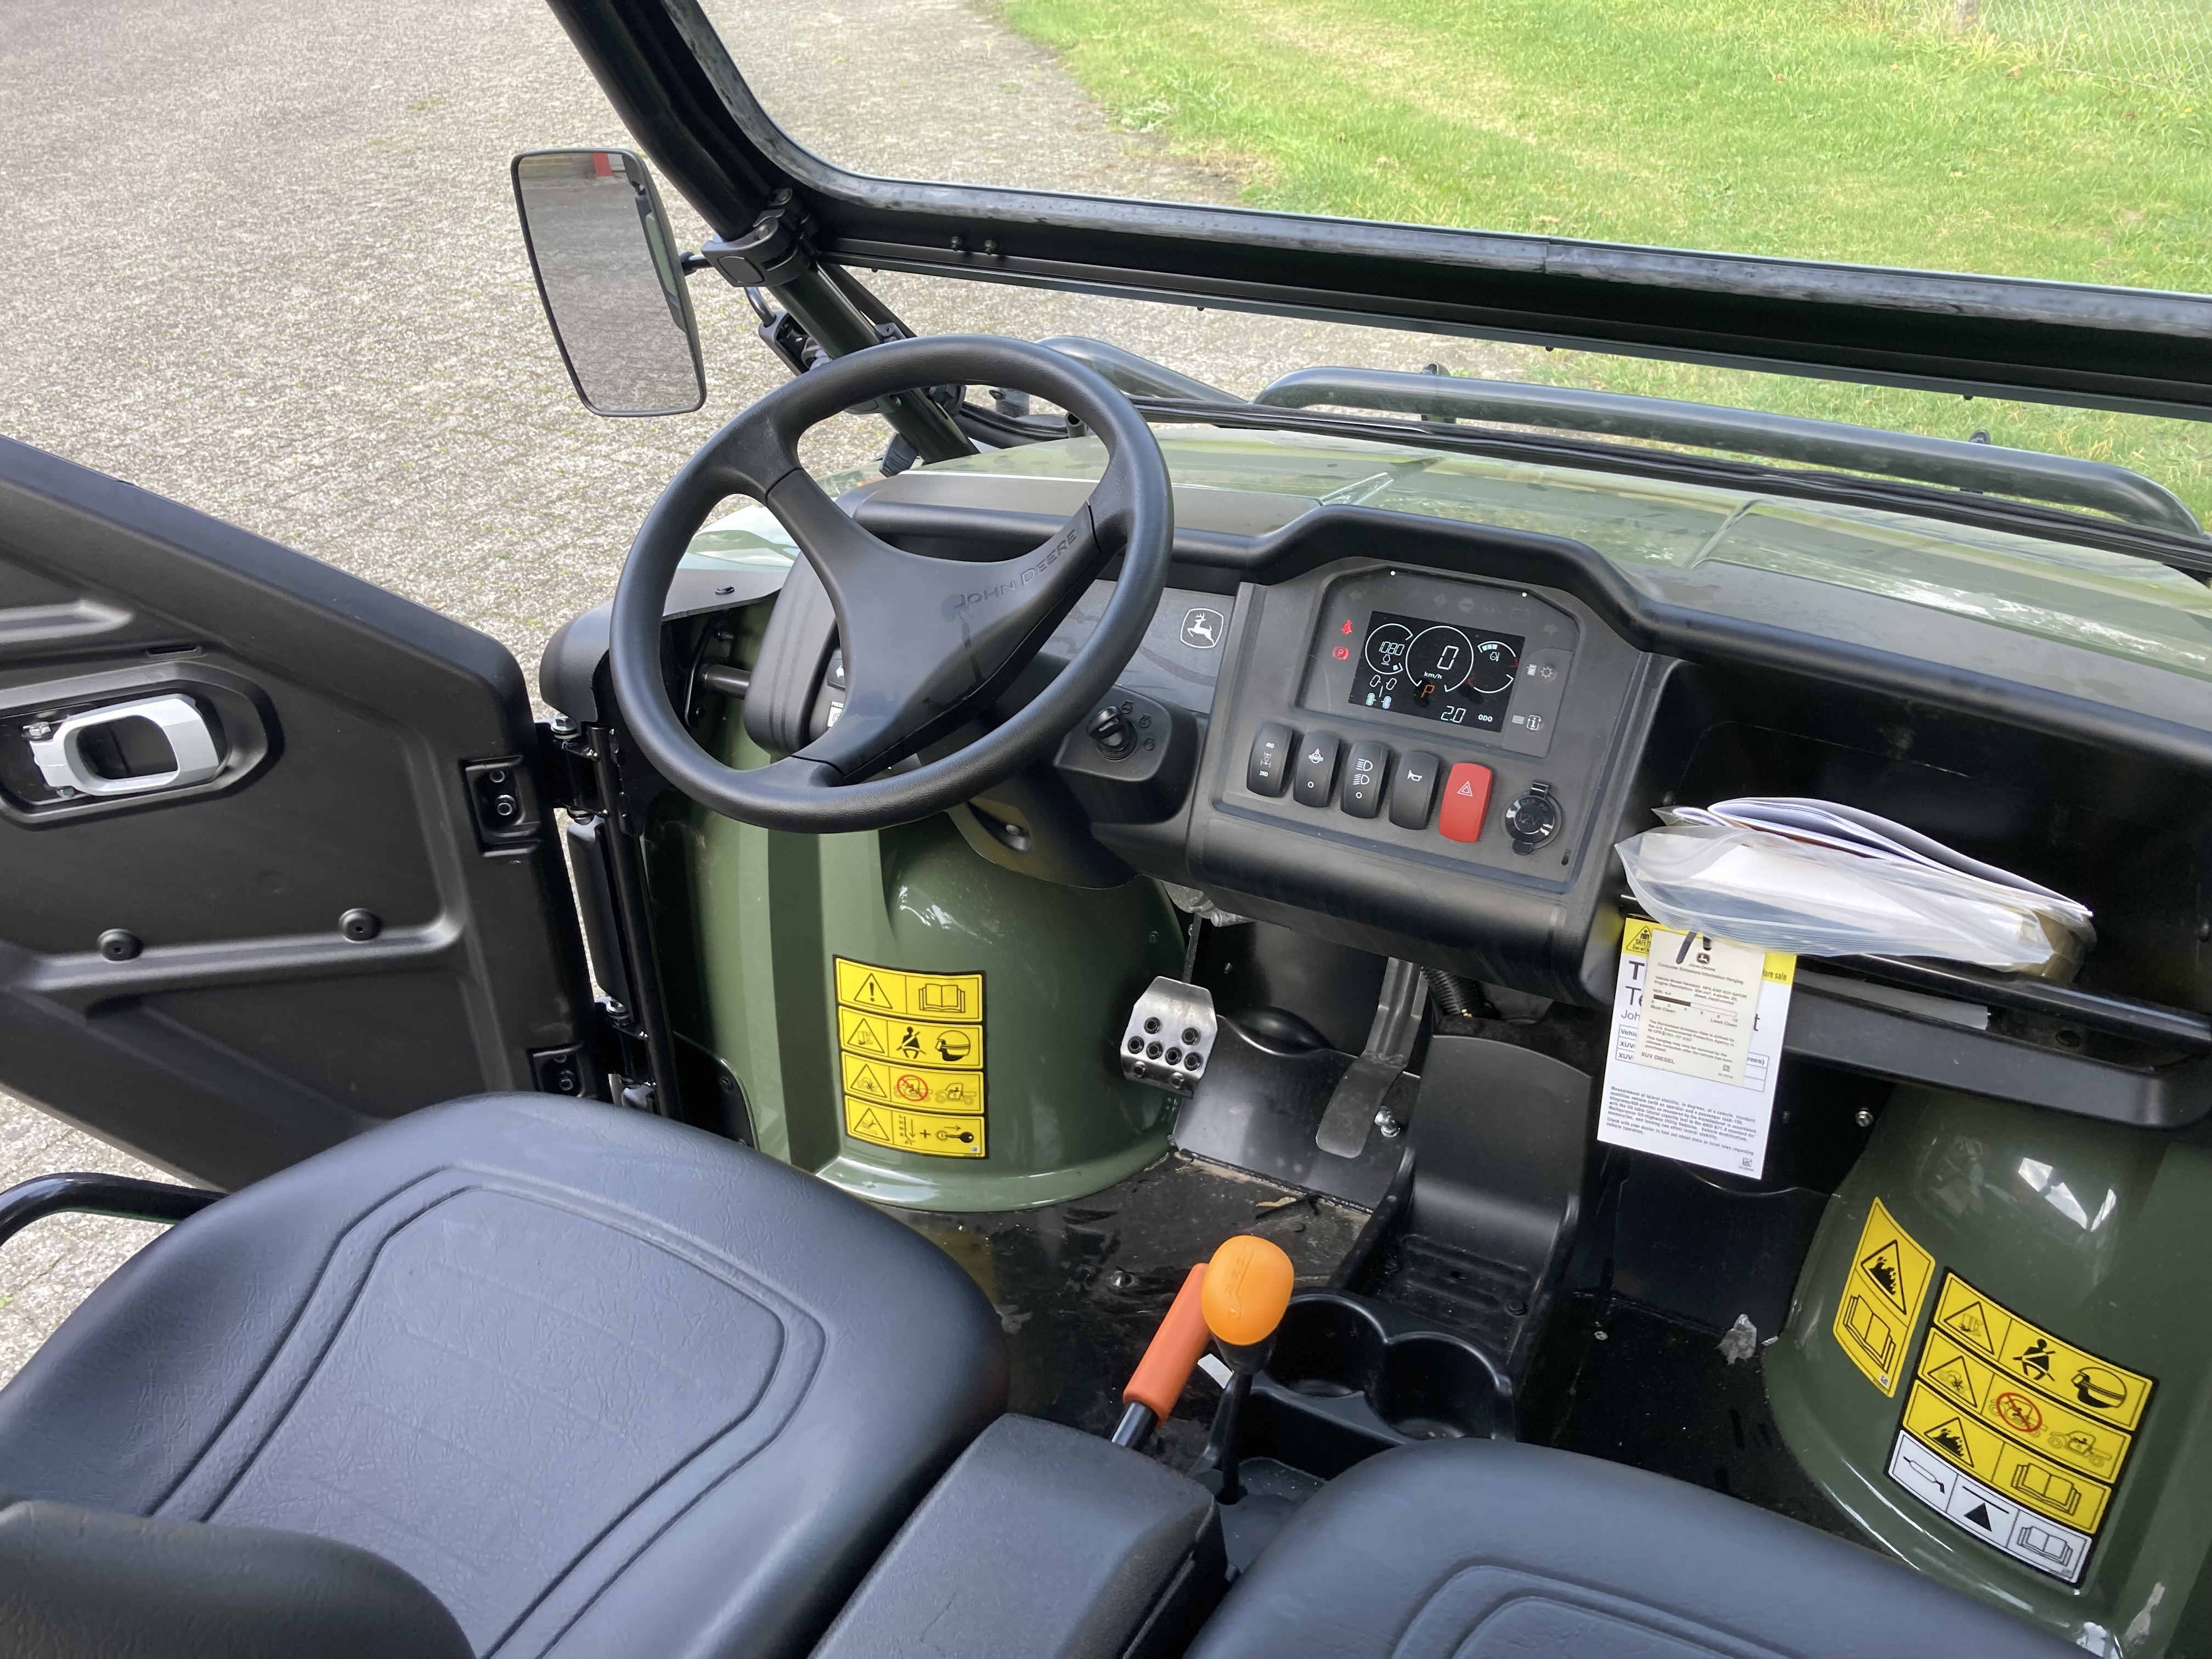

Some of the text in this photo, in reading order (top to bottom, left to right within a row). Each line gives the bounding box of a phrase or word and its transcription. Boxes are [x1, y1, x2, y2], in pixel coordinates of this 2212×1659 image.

[955, 529, 1077, 608] JOHN DEERE
[1379, 641, 1405, 656] 1080
[1436, 645, 1459, 670] 0
[1424, 671, 1443, 680] km/h
[1420, 684, 1435, 698] P
[1440, 706, 1493, 723] 2.0 ODO
[1519, 812, 1541, 826] 12V
[1657, 962, 1679, 970] Consumer
[1701, 971, 1725, 980] Information
[1725, 977, 1743, 985] Hangtag
[1763, 969, 1787, 980] fore sale
[1668, 983, 1692, 991] Description:
[1707, 996, 1734, 1005] liquid-cooled
[1621, 1009, 1640, 1022] Joh
[1621, 1028, 1638, 1037] Vehic
[1692, 1034, 1713, 1042] Protection
[1654, 1054, 1675, 1064] DIESEL
[1747, 1057, 1765, 1065] rees)
[1611, 1086, 1640, 1096] Measurement
[1661, 1098, 1680, 1106] stability,
[1686, 1103, 1706, 1111] degrees,
[1607, 1110, 1634, 1120] accessories,
[1644, 1119, 1660, 1127] loading
[1608, 1105, 1636, 1115] Multipurpose
[1637, 1112, 1663, 1122] Off-Highway
[1678, 1121, 1697, 1130] Vehicles.
[1662, 1108, 1683, 1116] measured
[1697, 1116, 1726, 1126] manufacturer
[1731, 1125, 1756, 1133] accordance
[1698, 1111, 1720, 1120] passenger
[1622, 1126, 1644, 1134] operation.
[1732, 1147, 1753, 1156] regarding
